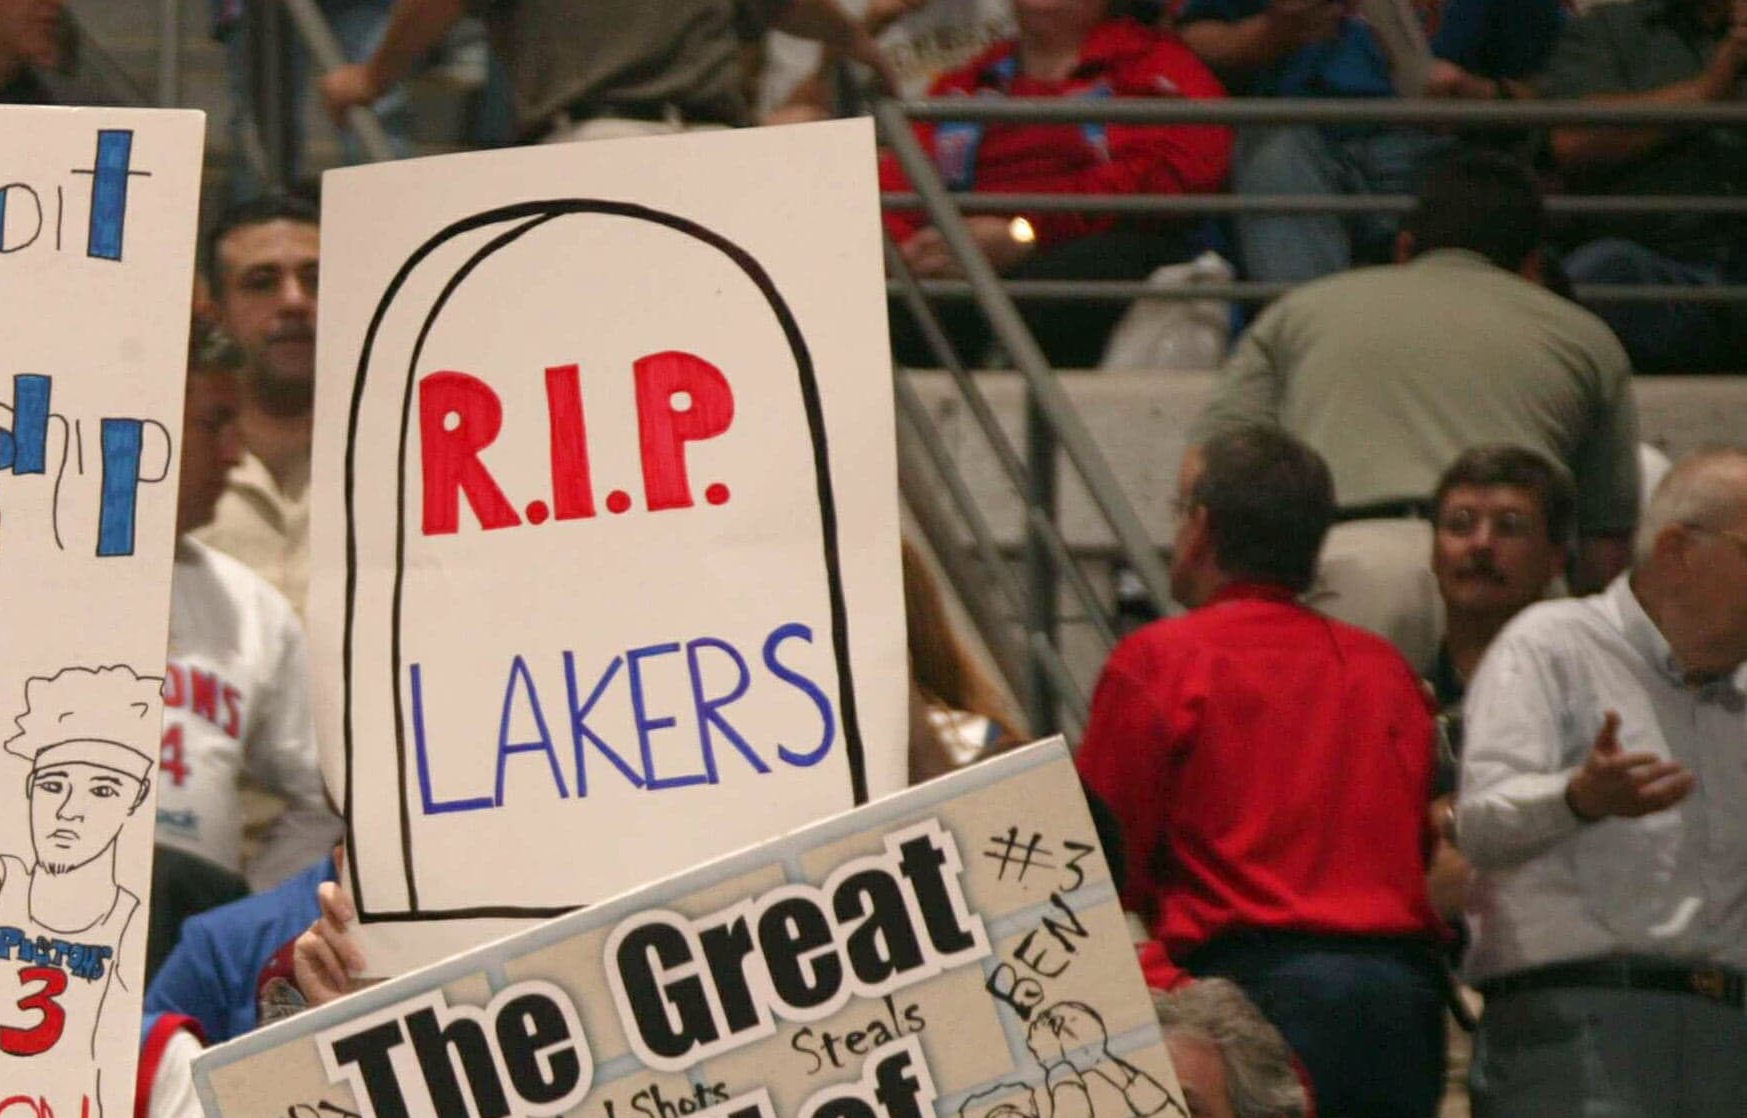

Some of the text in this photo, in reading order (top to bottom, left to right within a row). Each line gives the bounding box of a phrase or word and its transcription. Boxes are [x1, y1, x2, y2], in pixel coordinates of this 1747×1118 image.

[418, 350, 736, 536] R.I.P.
[163, 661, 242, 740] ONS
[410, 621, 837, 815] LAKERS
[984, 826, 1095, 893] #3
[616, 833, 975, 1058] Great
[985, 892, 1089, 1020] BEN
[790, 996, 926, 1075] Steals
